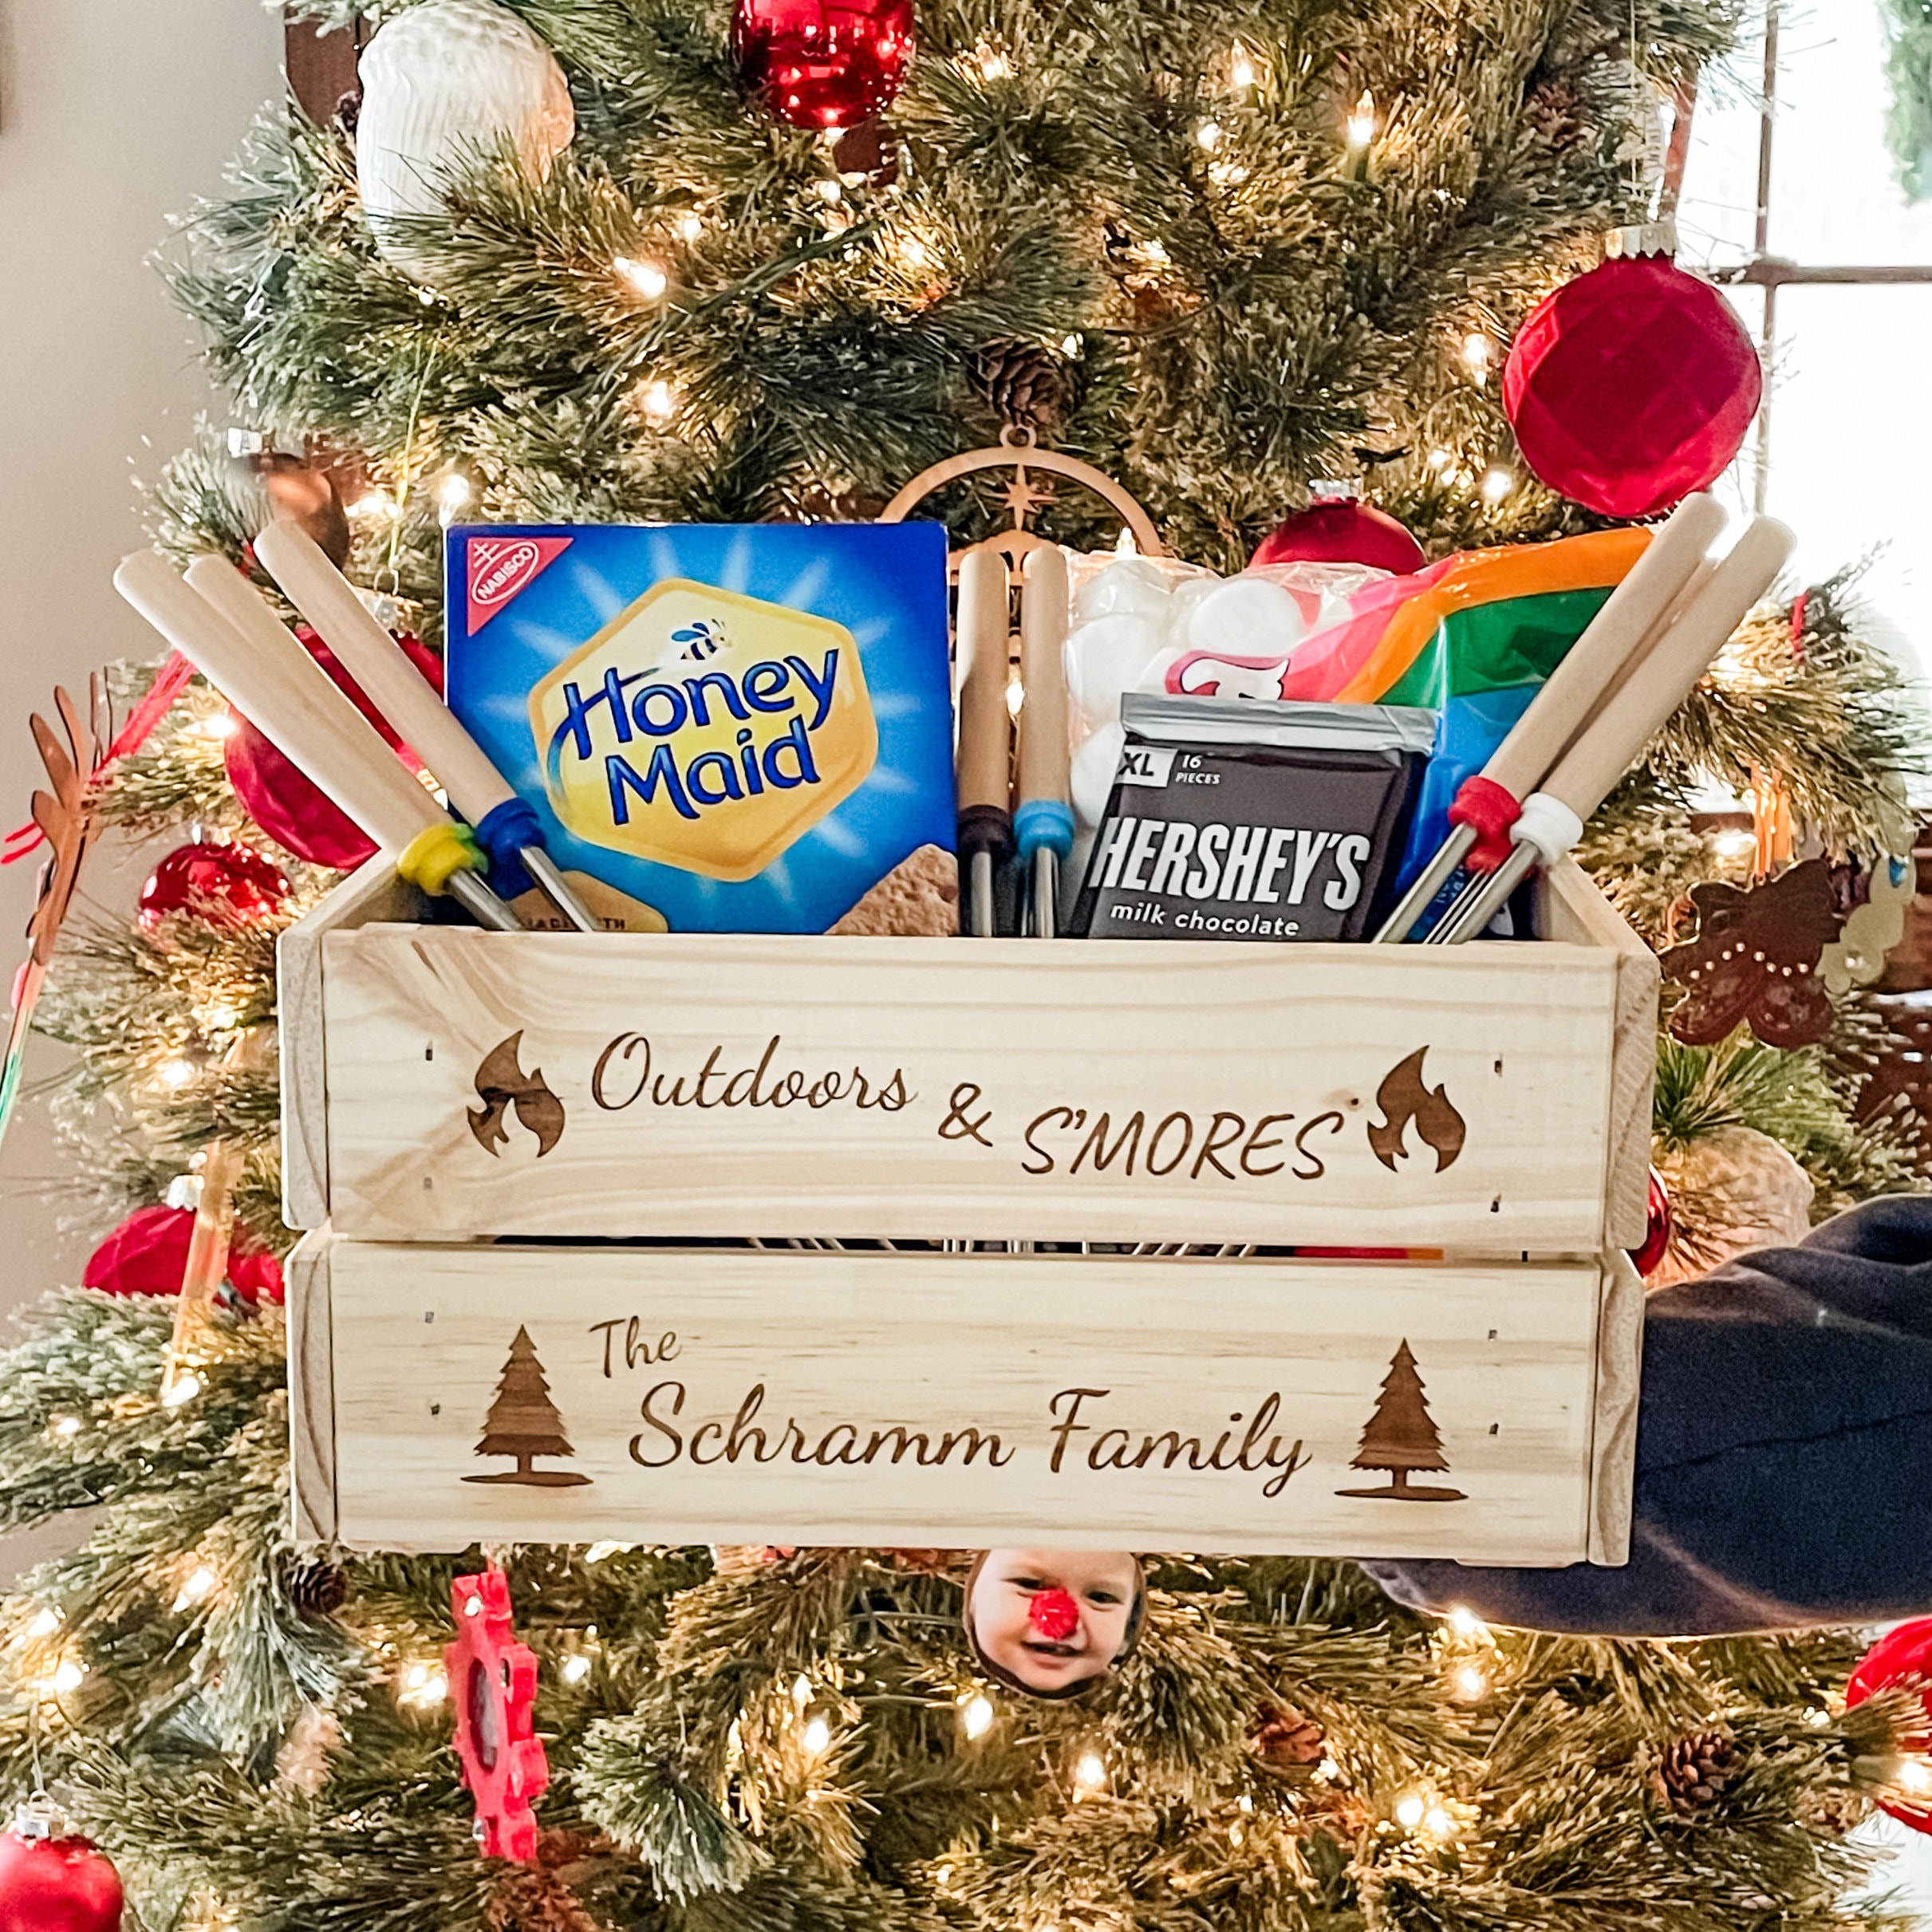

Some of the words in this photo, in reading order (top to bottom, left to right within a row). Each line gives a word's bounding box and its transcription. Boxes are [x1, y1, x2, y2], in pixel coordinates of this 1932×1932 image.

[477, 546, 534, 599] NABISCO
[552, 648, 840, 759] Honey
[605, 714, 821, 825] Maid
[1118, 751, 1154, 778] XL
[1175, 771, 1221, 785] PIECES
[1181, 754, 1203, 769] 16
[1088, 816, 1370, 912] HERSHEY'S
[1110, 902, 1168, 925] milk
[1174, 909, 1299, 936] chocolate
[592, 1031, 917, 1111] Outdoors
[937, 1082, 993, 1148] &
[1021, 1106, 1345, 1181] S'MORES
[589, 1315, 682, 1378] The
[629, 1381, 1016, 1468] Schramm
[1049, 1388, 1313, 1498] Family
